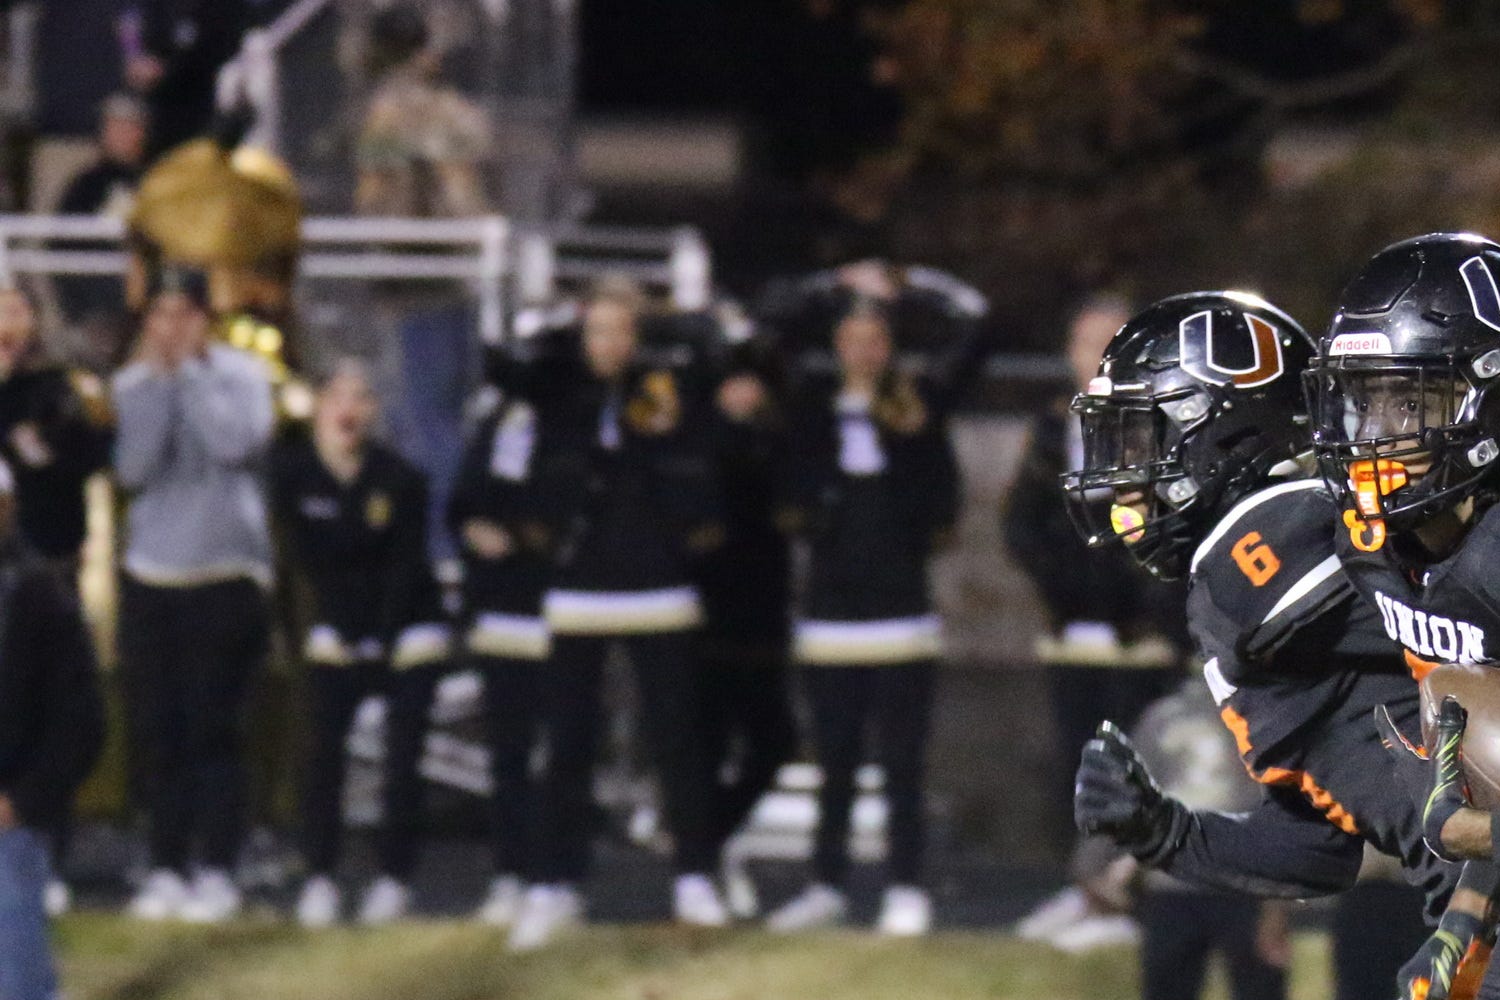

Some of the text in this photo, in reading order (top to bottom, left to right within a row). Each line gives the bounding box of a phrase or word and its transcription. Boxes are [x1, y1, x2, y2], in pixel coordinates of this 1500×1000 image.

[1179, 308, 1284, 389] U
[1335, 337, 1380, 351] Riddell
[1230, 530, 1281, 587] 6
[1374, 590, 1486, 664] UNION
